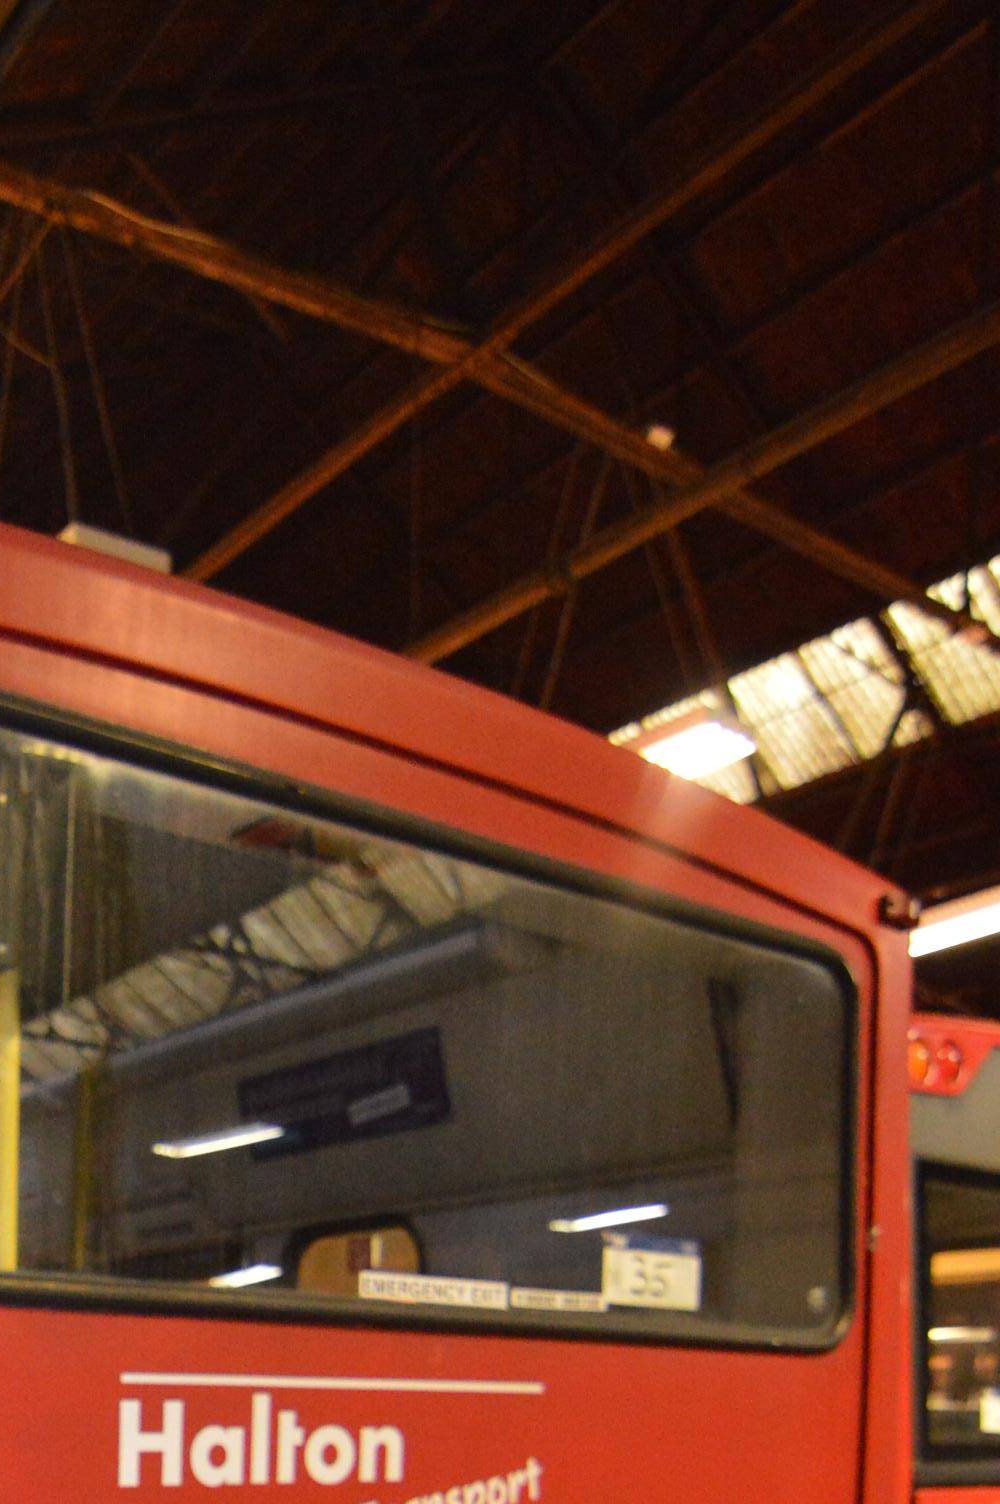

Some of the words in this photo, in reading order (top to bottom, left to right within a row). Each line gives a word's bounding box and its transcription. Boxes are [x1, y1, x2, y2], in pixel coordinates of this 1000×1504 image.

[359, 1277, 465, 1302] EMERGENCY
[470, 1285, 505, 1306] EXIT
[117, 1391, 405, 1488] Halton
